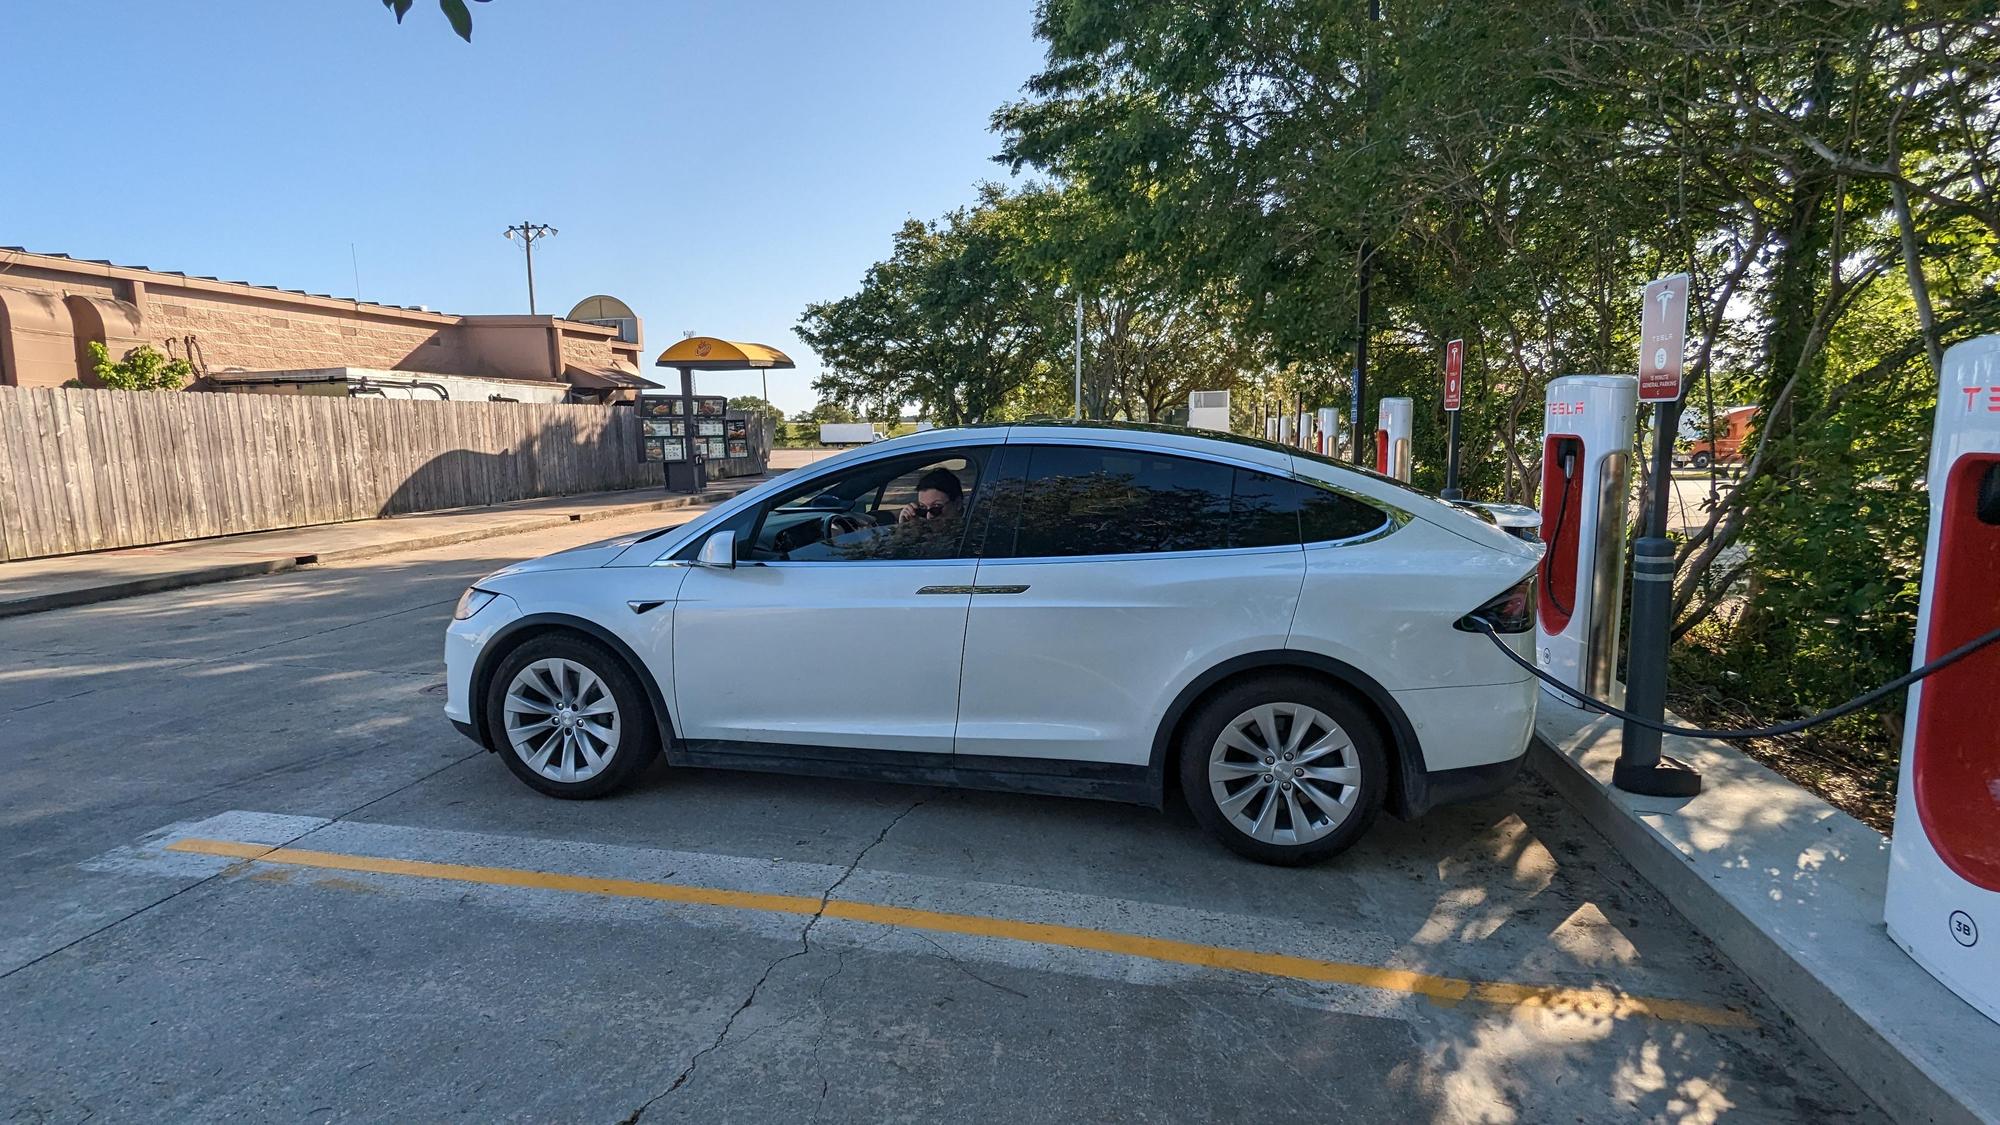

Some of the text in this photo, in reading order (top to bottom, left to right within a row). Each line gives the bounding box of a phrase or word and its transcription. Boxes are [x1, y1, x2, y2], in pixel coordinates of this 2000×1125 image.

[1652, 333, 1673, 342] TESLA
[1548, 401, 1584, 415] TESLA
[1956, 920, 1970, 936] 3B
